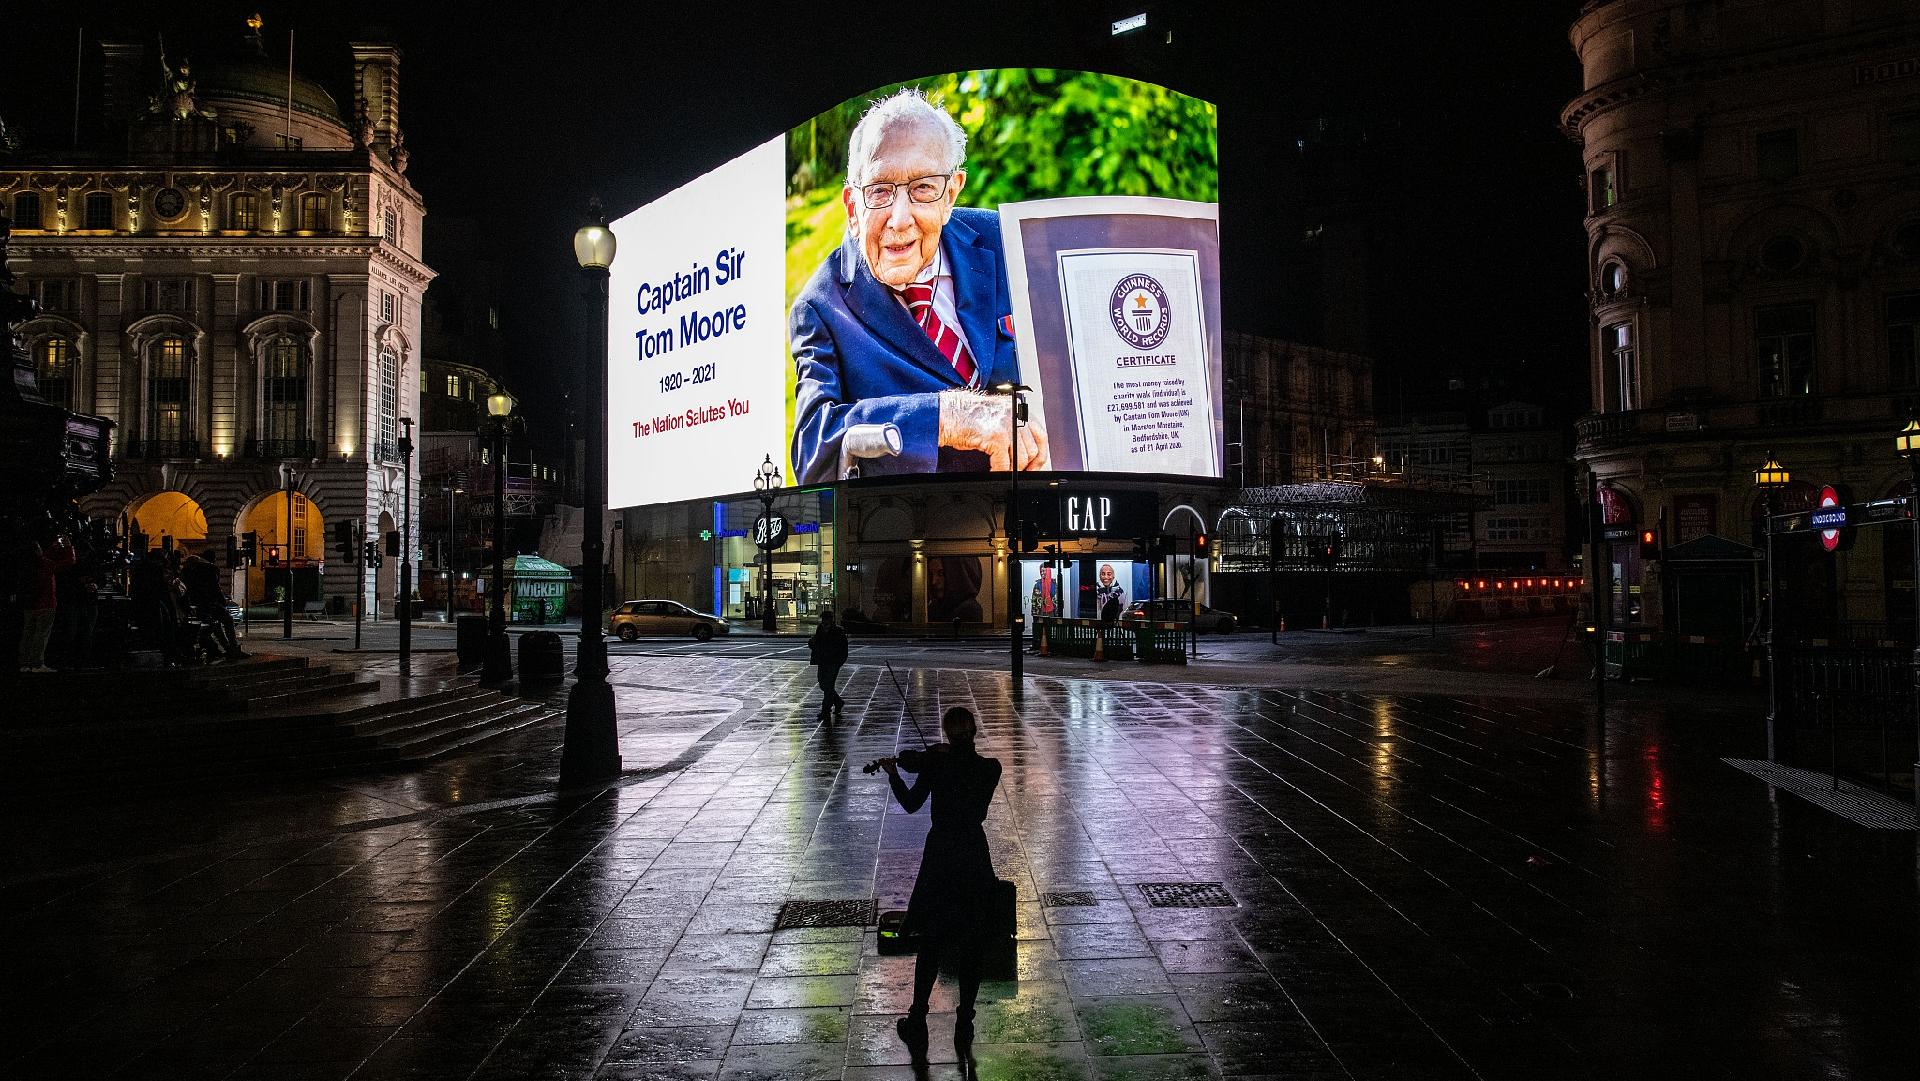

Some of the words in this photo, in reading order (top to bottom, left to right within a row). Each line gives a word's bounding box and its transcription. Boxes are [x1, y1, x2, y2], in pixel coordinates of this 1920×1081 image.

[637, 263, 710, 315] Captain
[716, 247, 745, 286] Sir
[1118, 278, 1162, 299] GUINNESS
[636, 327, 673, 361] Tom
[680, 303, 746, 348] Moore
[1114, 307, 1139, 343] WORLD
[1142, 307, 1168, 346] RECORDS
[1116, 354, 1176, 367] CERTIFICATE
[660, 373, 682, 394] 1920
[692, 362, 716, 384] 2021
[632, 421, 650, 438] The
[652, 412, 684, 434] Nation
[686, 405, 726, 428] Salutes
[728, 398, 750, 417] You
[1114, 414, 1122, 424] by
[1123, 412, 1146, 422] Captain
[1146, 400, 1158, 408] and
[1170, 398, 1193, 407] achieved
[1140, 443, 1146, 452] of
[1068, 496, 1111, 531] GAP
